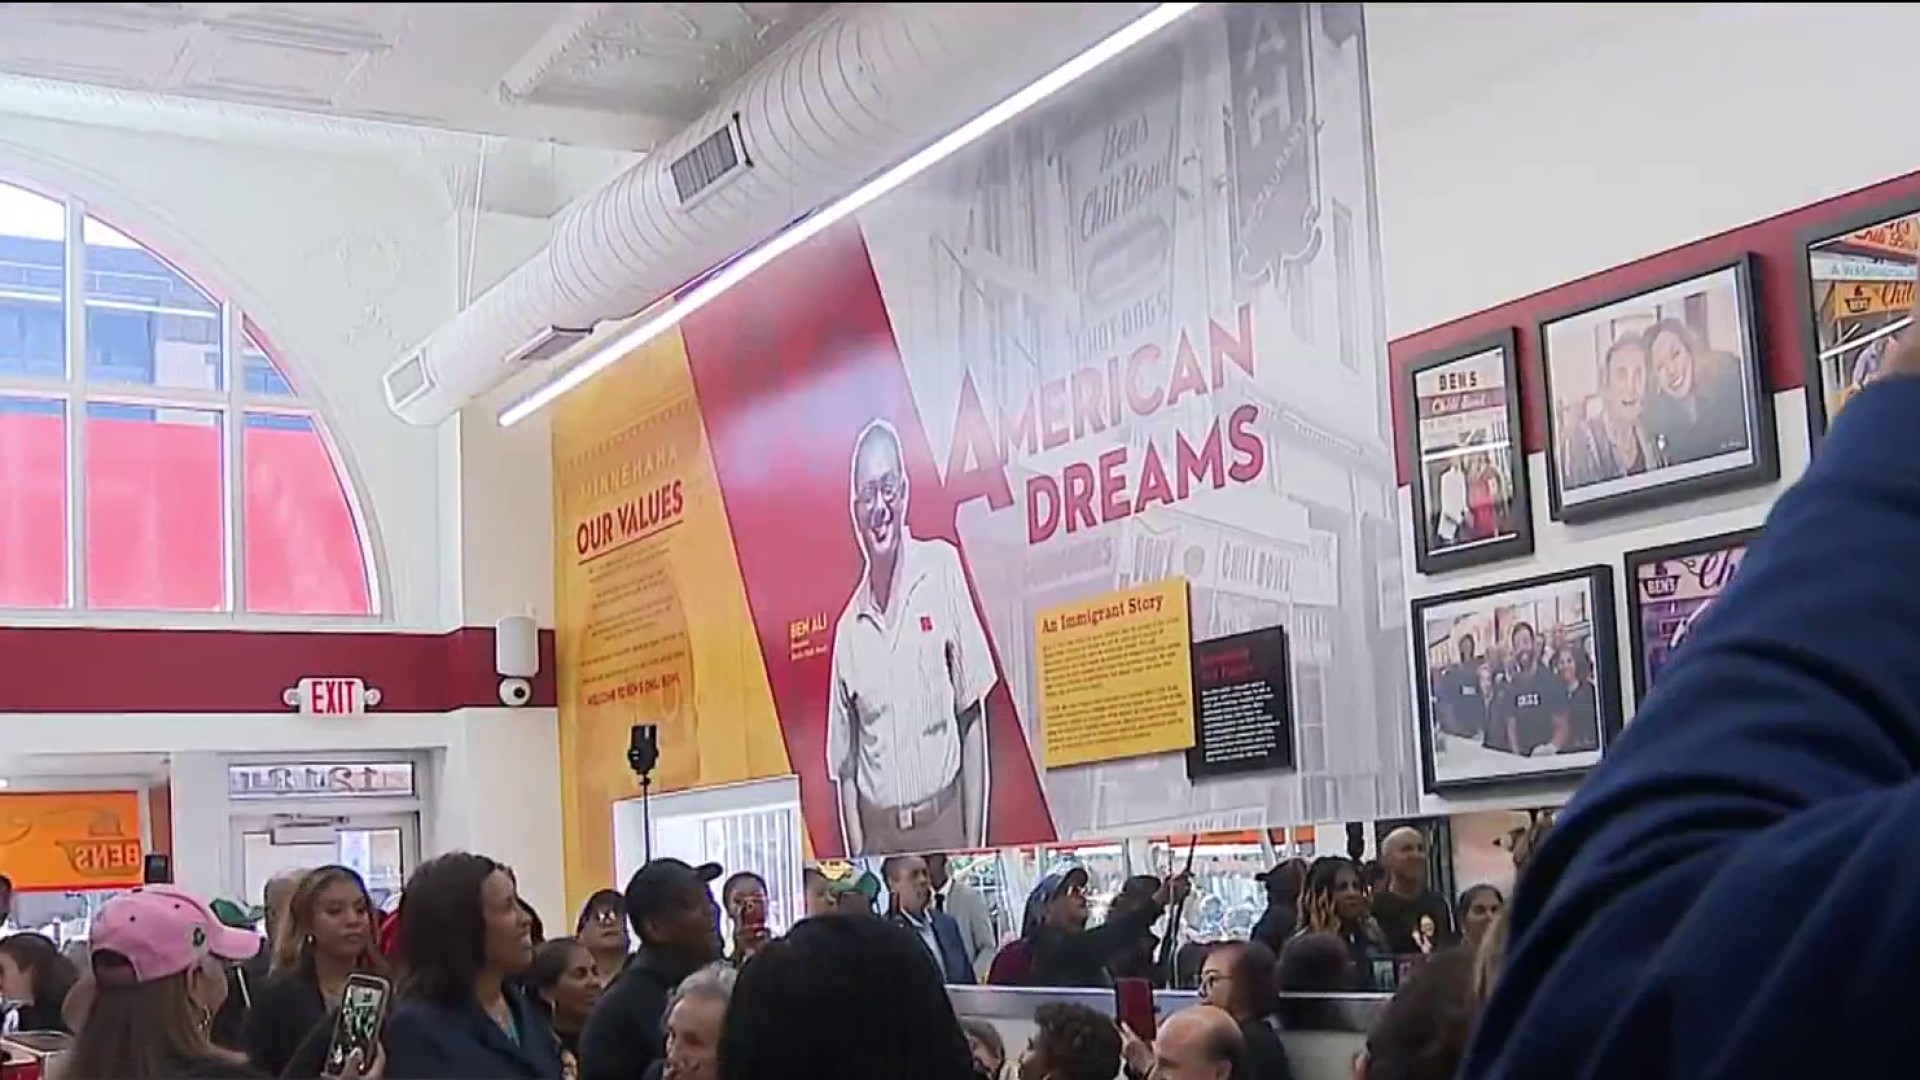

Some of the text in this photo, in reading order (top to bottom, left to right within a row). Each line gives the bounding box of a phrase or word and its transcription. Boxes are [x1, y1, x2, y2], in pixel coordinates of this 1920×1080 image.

[943, 302, 1256, 513] AMERICAN
[1026, 404, 1266, 544] DREAMS
[577, 480, 684, 555] OUR VALUES
[791, 611, 828, 639] BEN ALI
[1042, 594, 1165, 634] An Immigrant Story
[311, 680, 356, 714] EXIT
